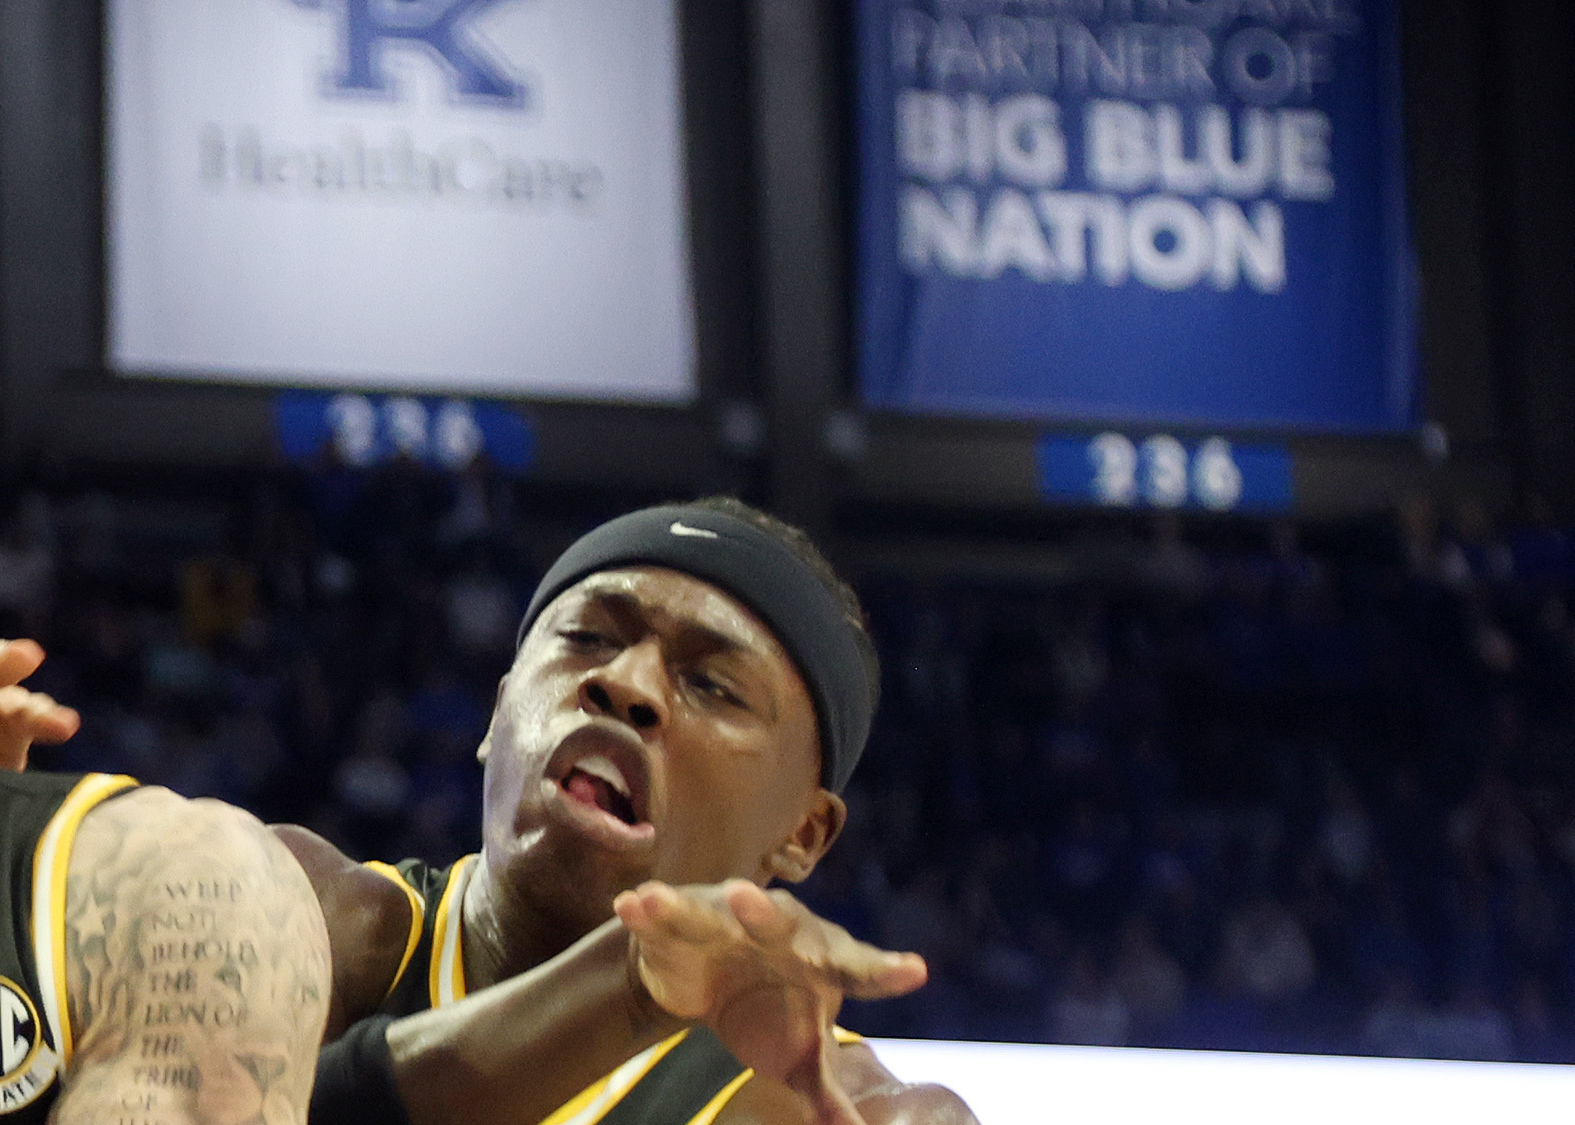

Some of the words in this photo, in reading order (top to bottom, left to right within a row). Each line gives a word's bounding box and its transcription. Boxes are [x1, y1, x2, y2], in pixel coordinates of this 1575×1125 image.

[1225, 24, 1337, 101] OF
[196, 122, 603, 204] HealthCare
[895, 89, 1066, 188] BIG
[1086, 98, 1333, 200] BLUE
[897, 184, 1288, 294] NATION
